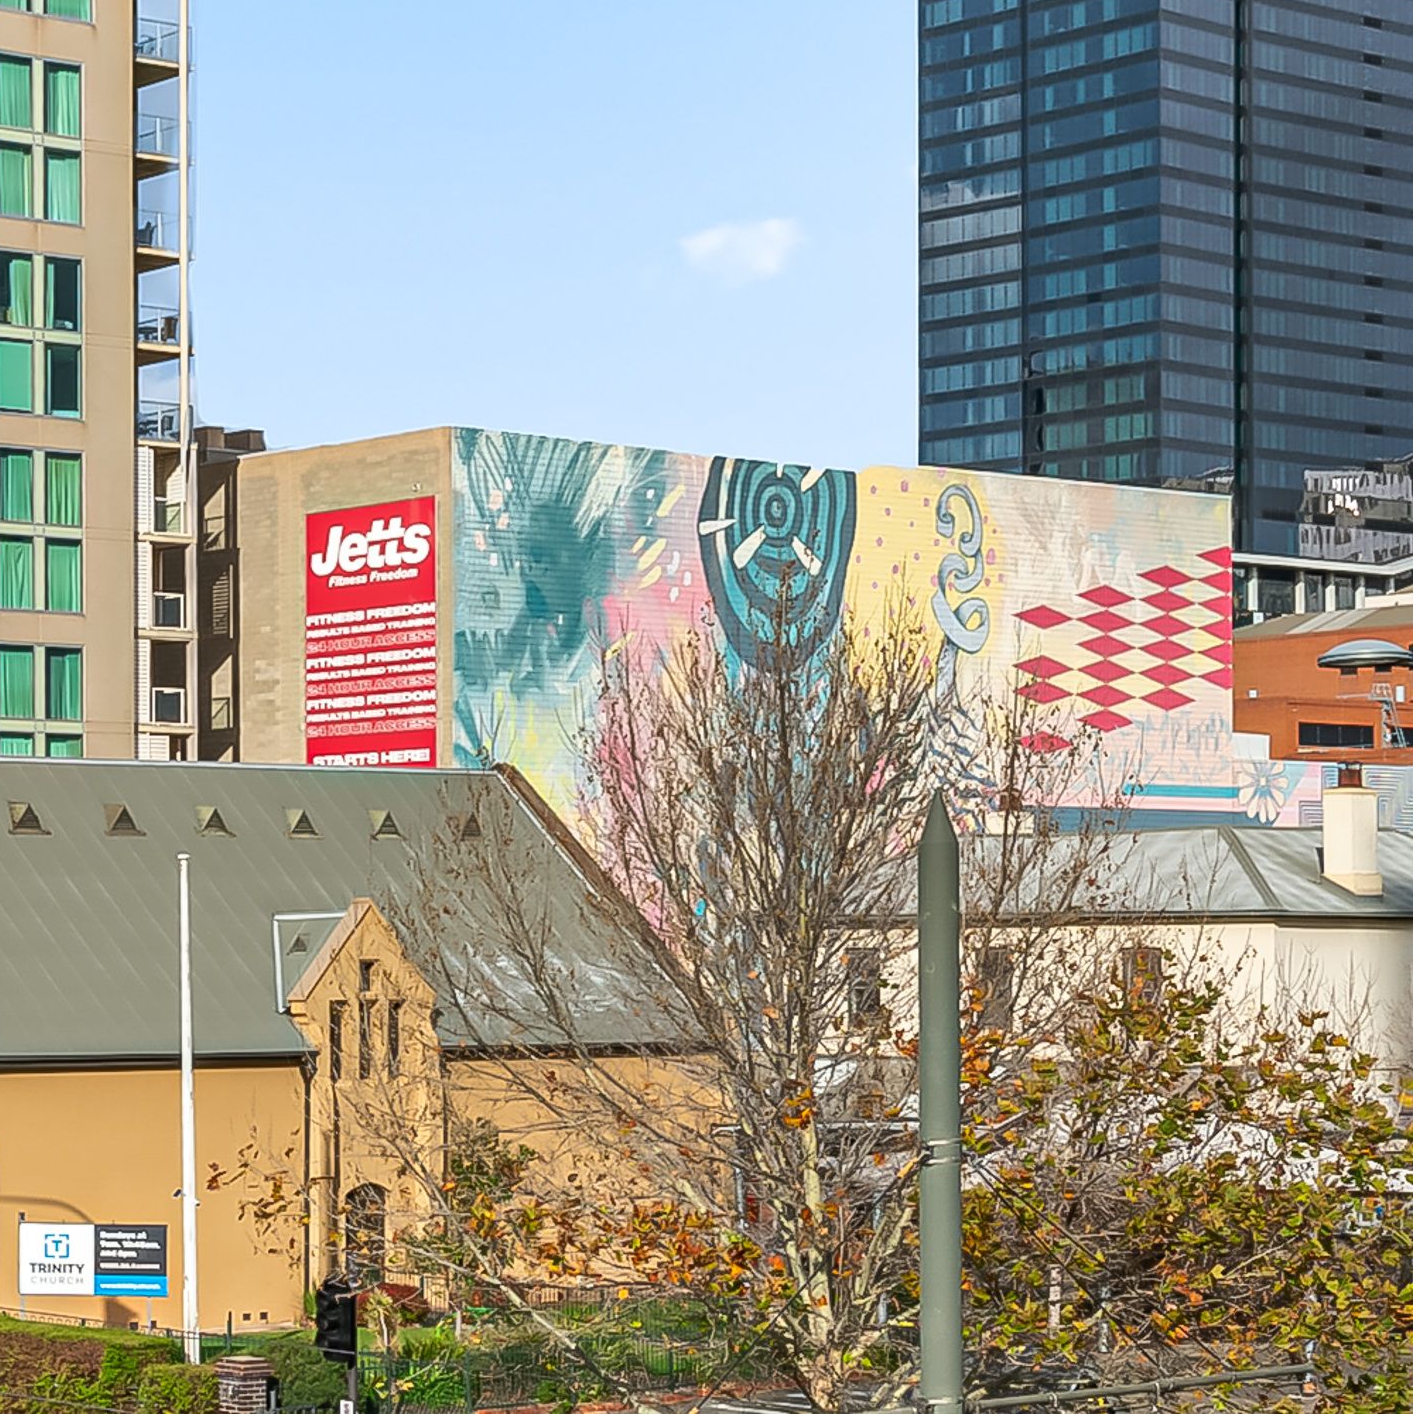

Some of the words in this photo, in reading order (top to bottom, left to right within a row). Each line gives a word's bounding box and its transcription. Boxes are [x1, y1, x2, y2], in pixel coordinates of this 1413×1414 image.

[310, 516, 432, 576] Jetts
[328, 573, 367, 588] Fitness
[369, 567, 419, 583] Freedom
[306, 610, 365, 627] FITNESS
[366, 603, 436, 620] FREEDOM
[327, 637, 372, 651] HOUR
[373, 629, 436, 647] ACCESS
[306, 653, 365, 670] FITNESS
[366, 647, 436, 663] FREEDOM
[327, 680, 372, 694] HOUR
[373, 673, 436, 690] ACCESS
[306, 695, 365, 711] FITNESS
[366, 690, 436, 706] FREEDOM
[327, 721, 372, 736] HOUR
[373, 716, 436, 732] ACCESS
[313, 752, 379, 766] STARTS
[29, 1262, 85, 1274] TRINITY
[30, 1275, 84, 1285] CHURCH
